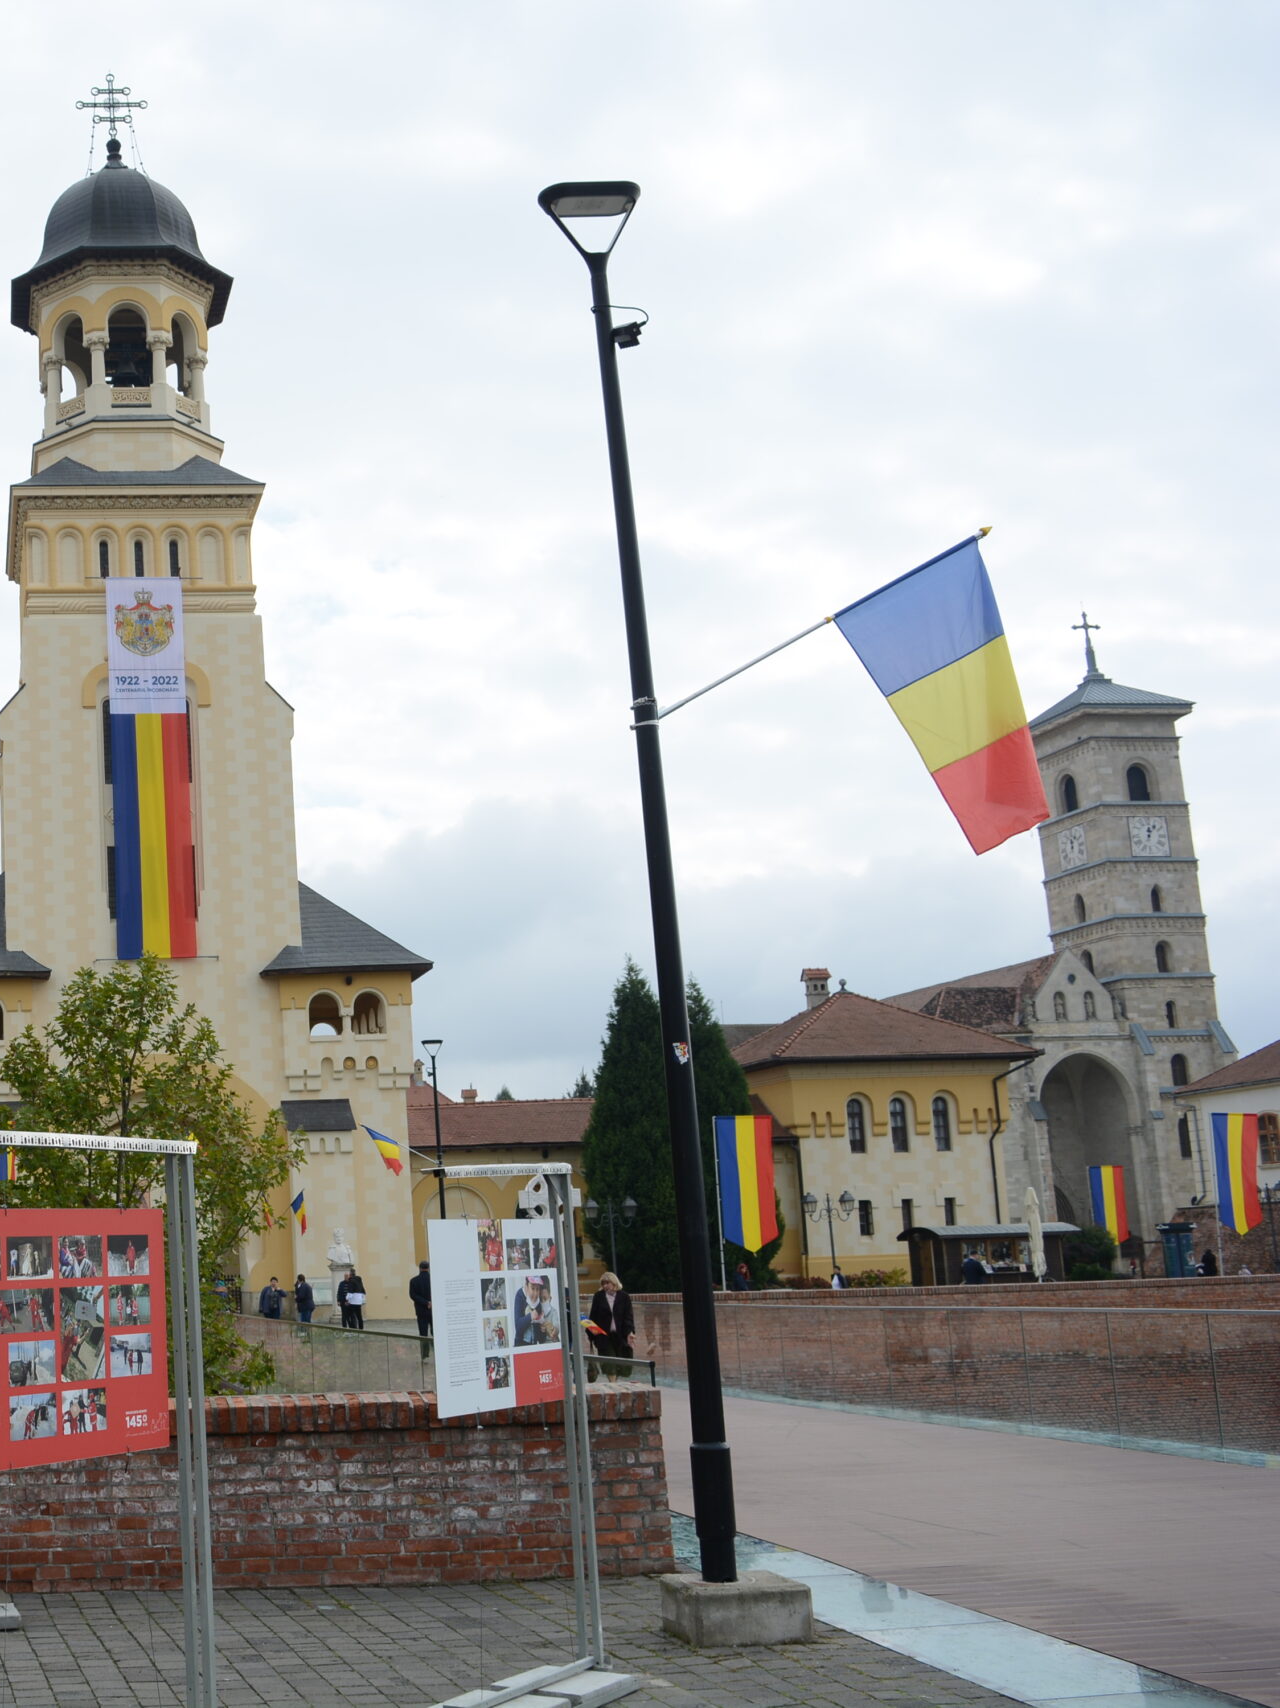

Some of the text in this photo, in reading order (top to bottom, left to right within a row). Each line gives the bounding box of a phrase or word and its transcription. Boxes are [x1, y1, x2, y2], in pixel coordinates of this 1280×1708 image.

[115, 676, 140, 686] 1922
[151, 676, 179, 686] 2022
[125, 1415, 143, 1428] 145
